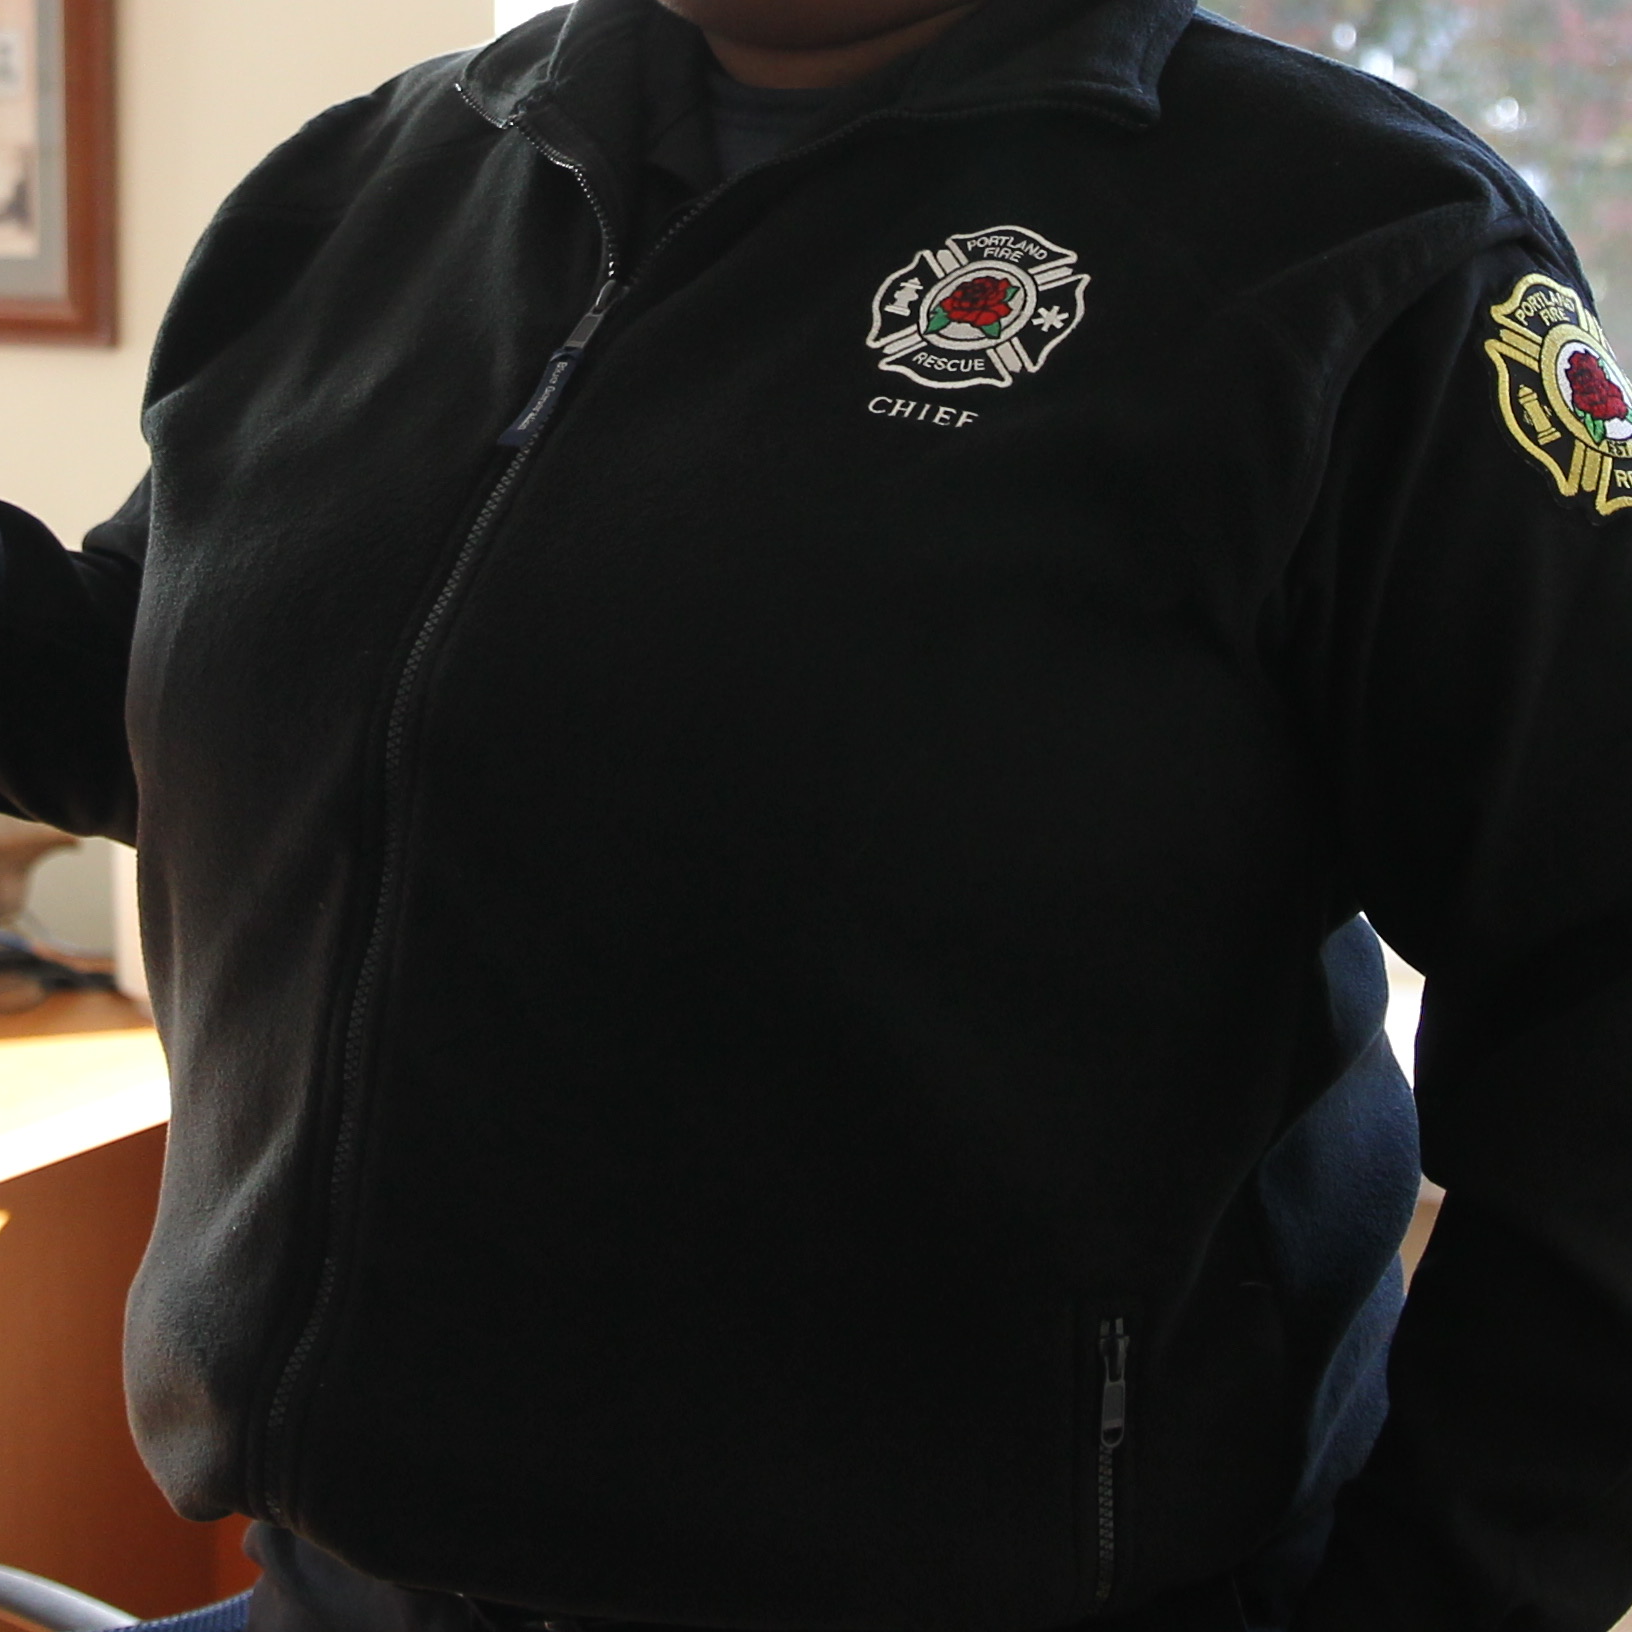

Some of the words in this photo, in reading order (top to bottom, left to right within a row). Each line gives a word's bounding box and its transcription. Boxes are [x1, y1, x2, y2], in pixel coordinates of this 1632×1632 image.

[966, 235, 1049, 261] PORTLAND
[983, 247, 1023, 263] FIRE
[1514, 292, 1575, 327] PORTLAND
[1539, 307, 1570, 327] FIRE
[912, 352, 986, 372] RESCUE
[868, 396, 979, 428] CHIEF
